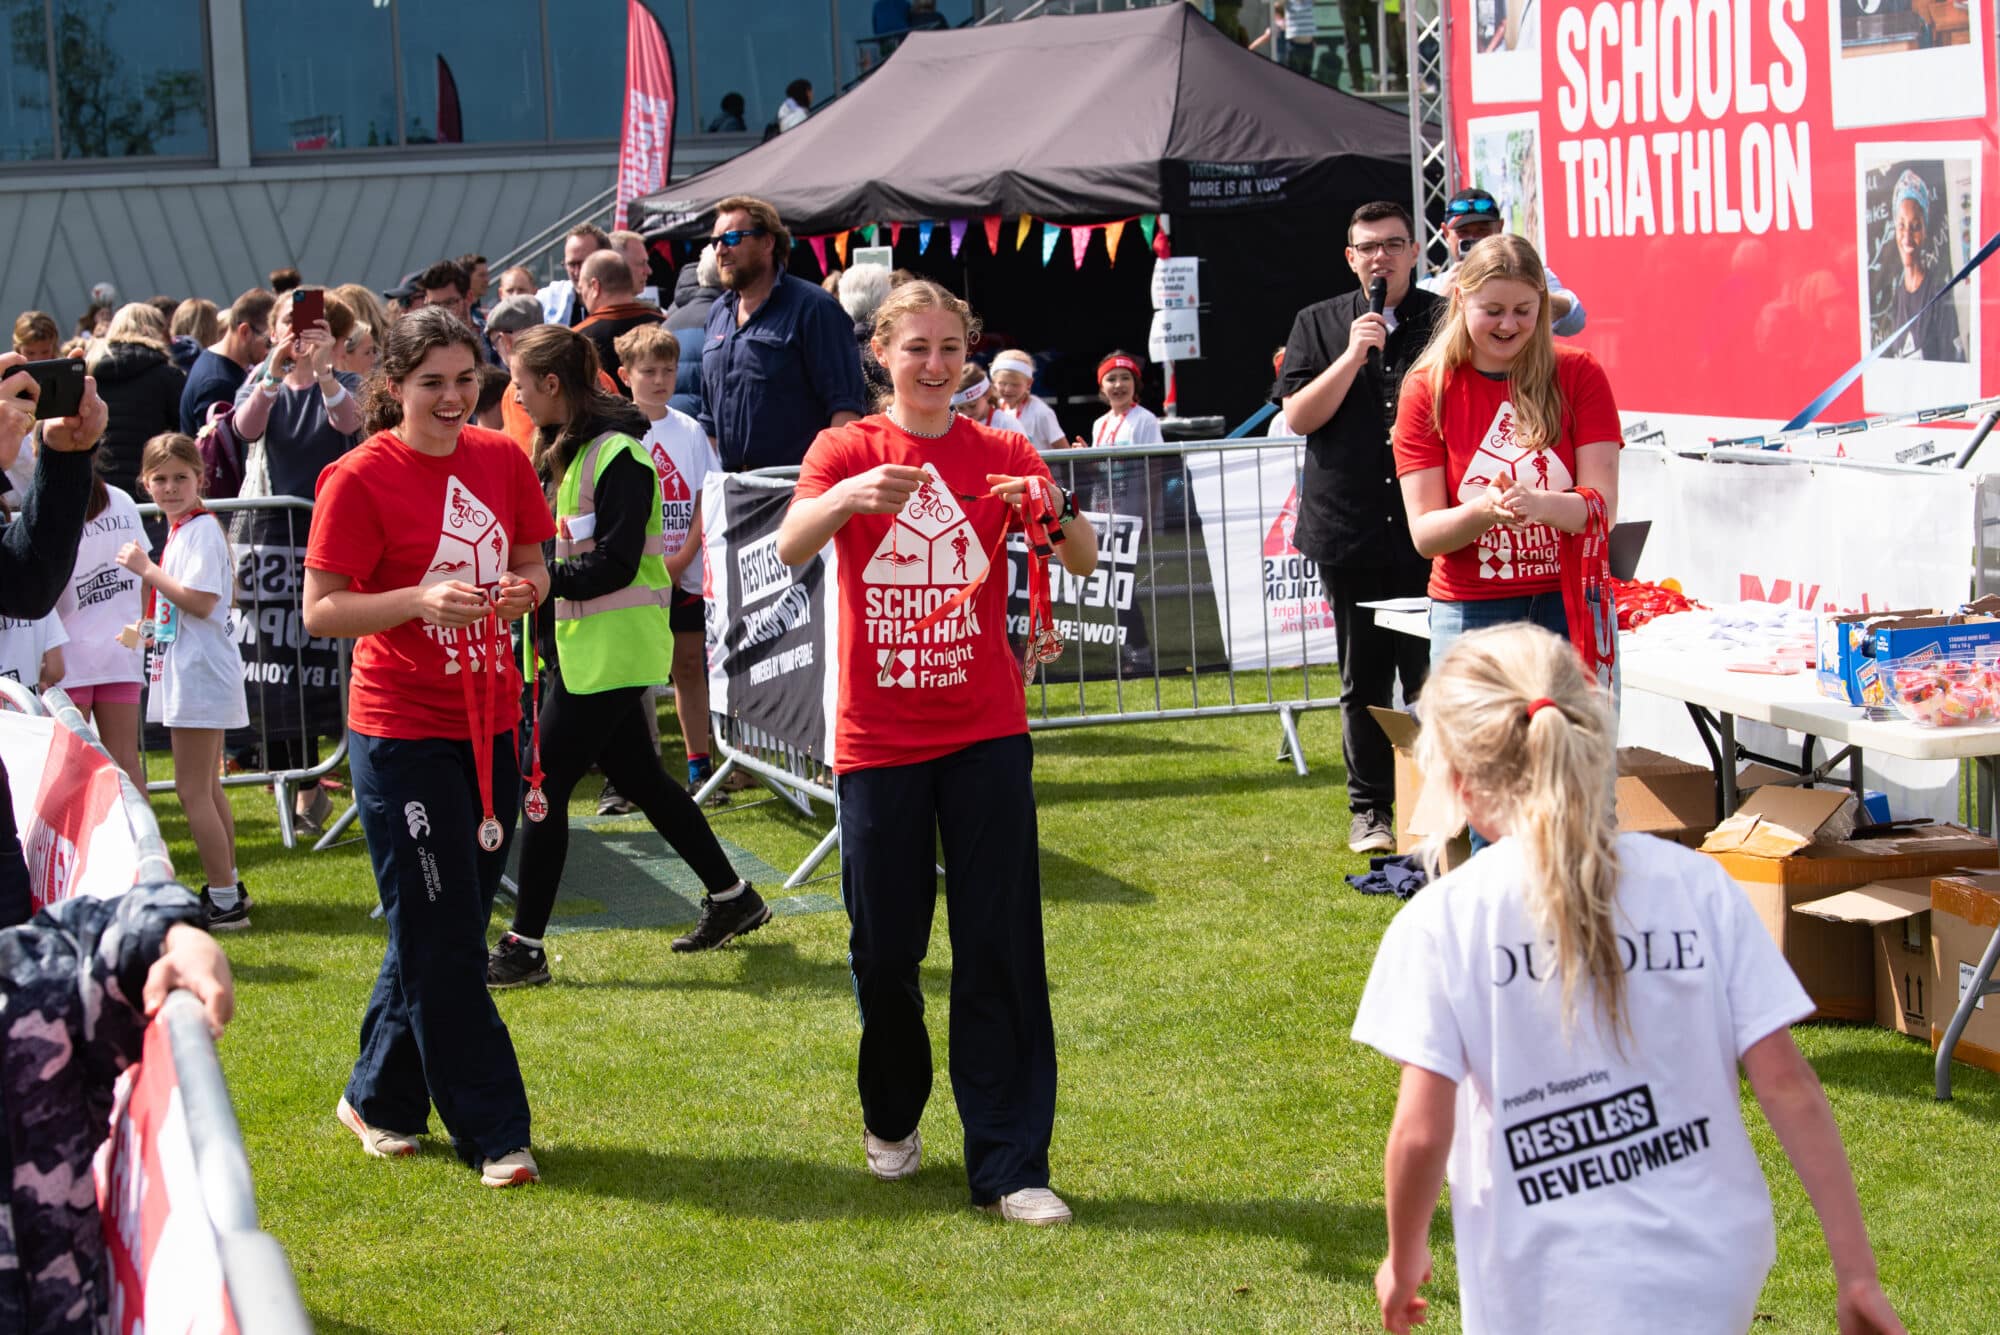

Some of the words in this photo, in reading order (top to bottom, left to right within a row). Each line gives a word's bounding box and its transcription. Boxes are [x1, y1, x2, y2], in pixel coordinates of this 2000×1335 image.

[1556, 0, 1807, 132] SCHOOLS
[1189, 181, 1221, 196] MORE
[1224, 181, 1236, 195] IS
[1239, 180, 1251, 194] IN
[1558, 121, 1813, 238] TRIATHLON
[662, 502, 691, 518] OOLS
[82, 515, 133, 538] UNDLE
[1517, 542, 1560, 562] Knigh
[865, 587, 979, 619] SCHOOL
[920, 644, 974, 669] Knight
[920, 666, 968, 688] Frank
[1502, 1087, 1545, 1112] Proudly
[1508, 1092, 1652, 1165] RESTLESS
[1517, 1117, 1711, 1206] DEVELOPMENT
